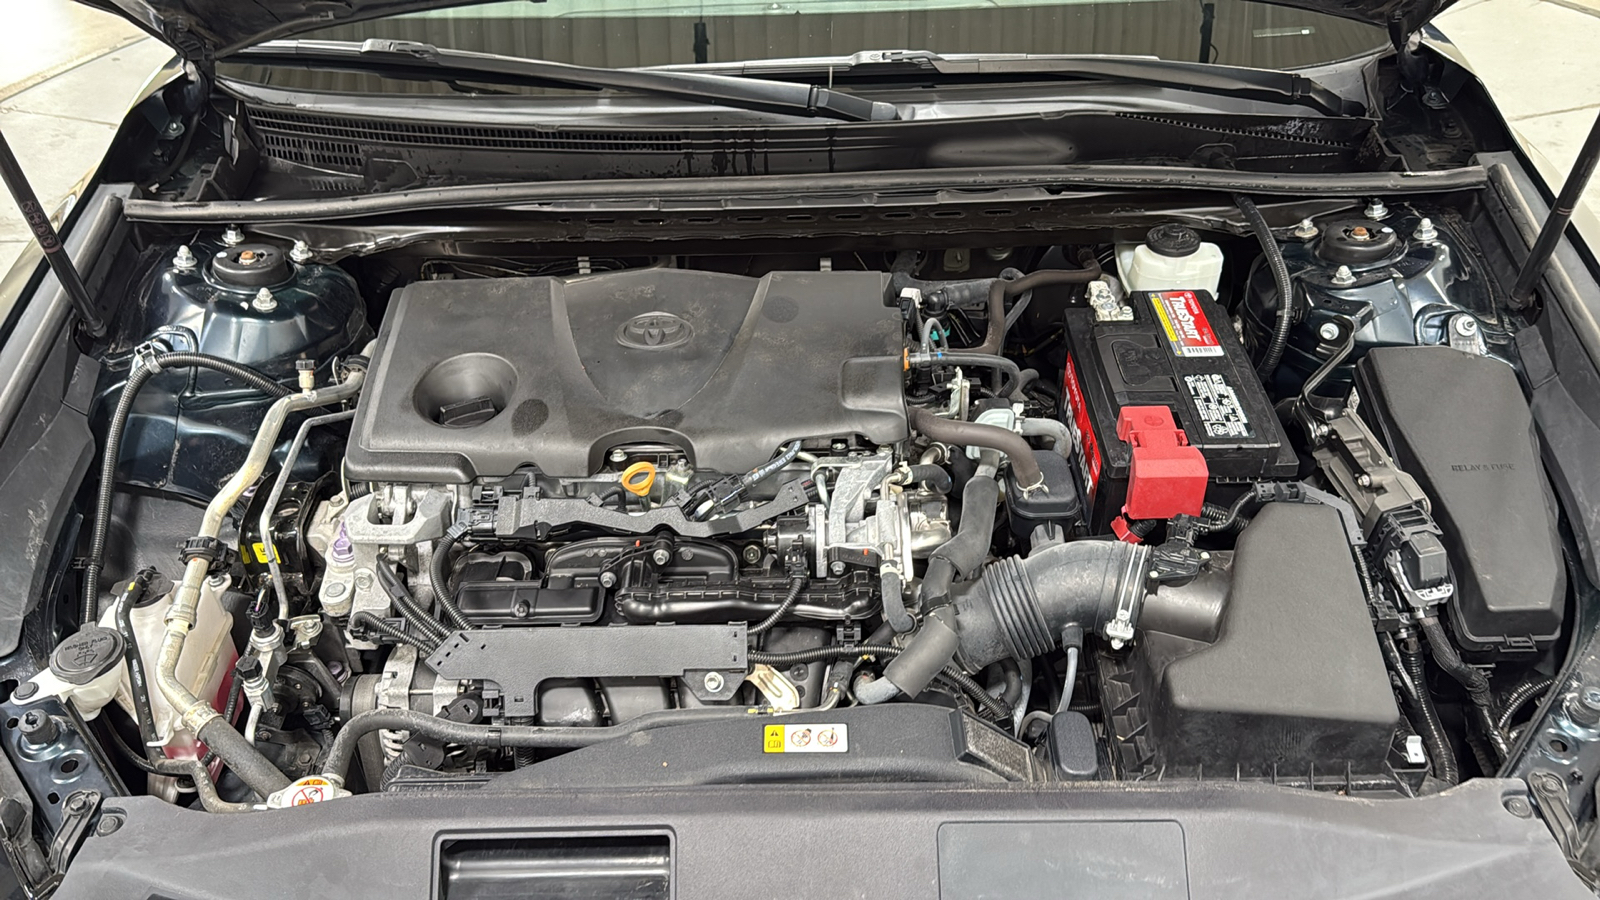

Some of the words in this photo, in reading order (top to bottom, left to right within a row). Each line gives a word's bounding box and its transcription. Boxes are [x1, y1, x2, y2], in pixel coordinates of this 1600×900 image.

[1451, 464, 1481, 472] RELAY
[1490, 463, 1516, 471] FUSE
[64, 641, 89, 652] WASHER
